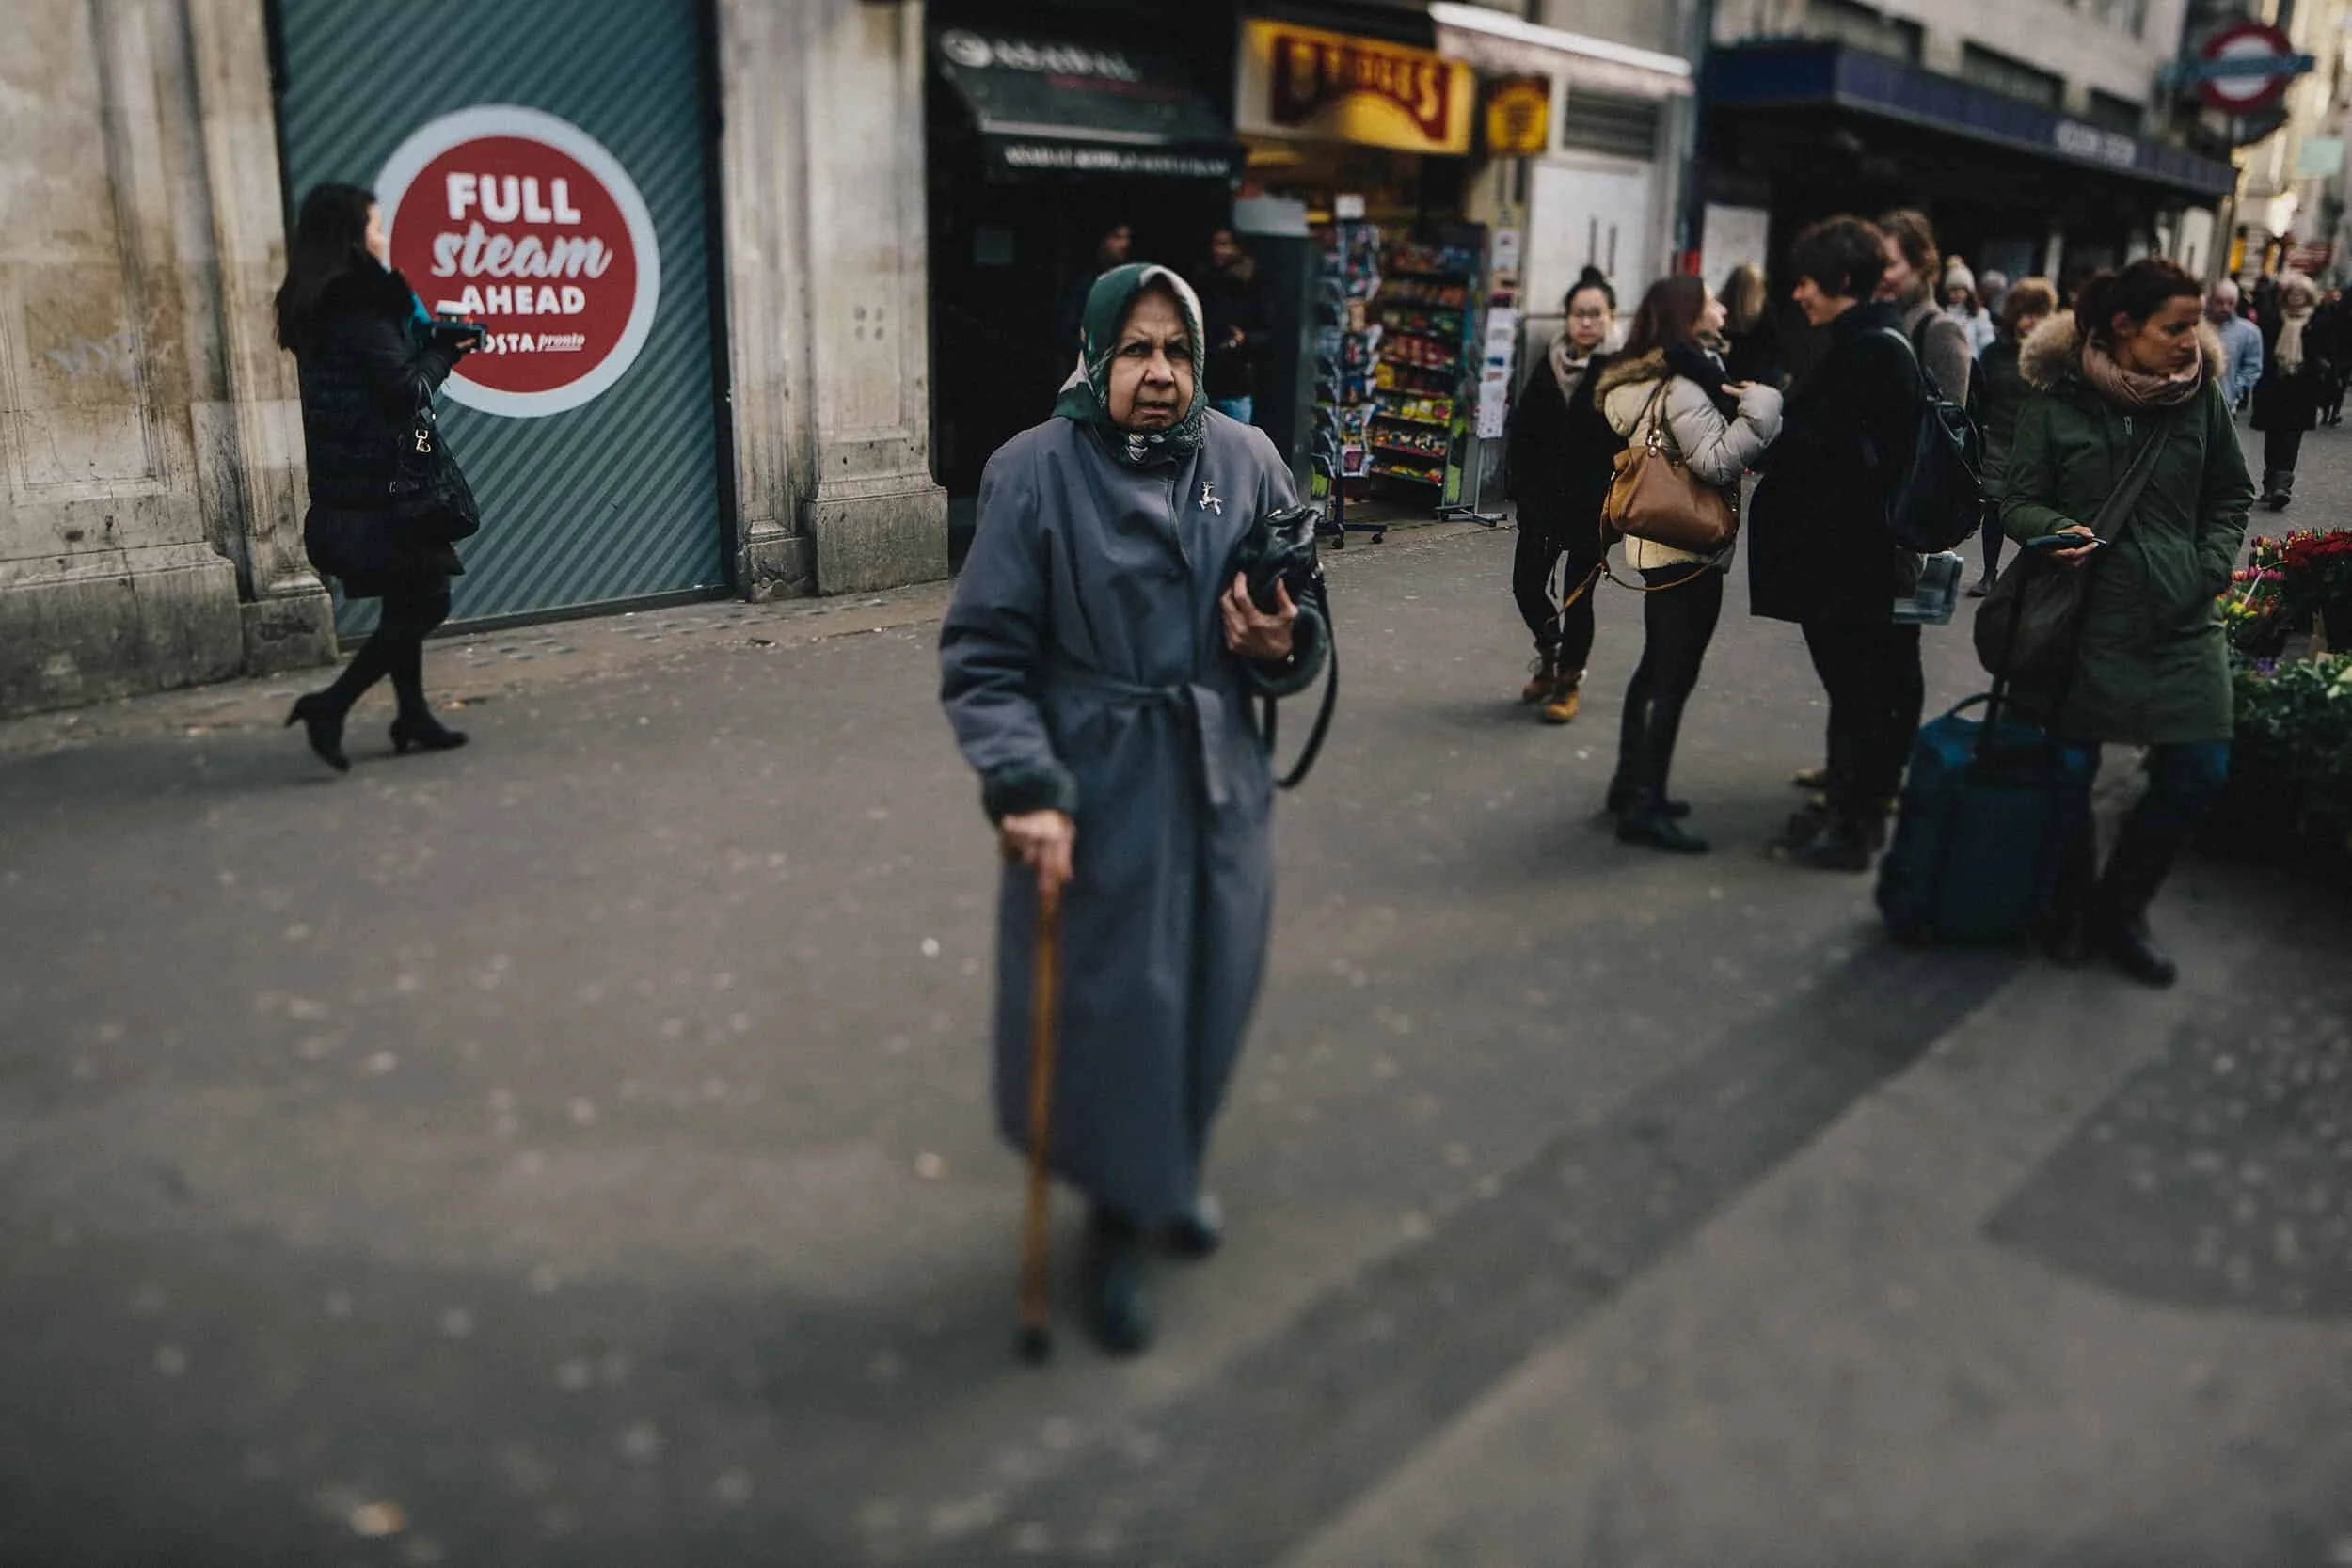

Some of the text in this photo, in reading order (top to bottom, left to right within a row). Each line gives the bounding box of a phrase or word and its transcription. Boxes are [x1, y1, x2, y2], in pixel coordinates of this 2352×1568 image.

[446, 172, 581, 225] FULL
[430, 220, 613, 278] steam
[461, 285, 586, 315] AHEAD
[469, 333, 534, 356] OSTA
